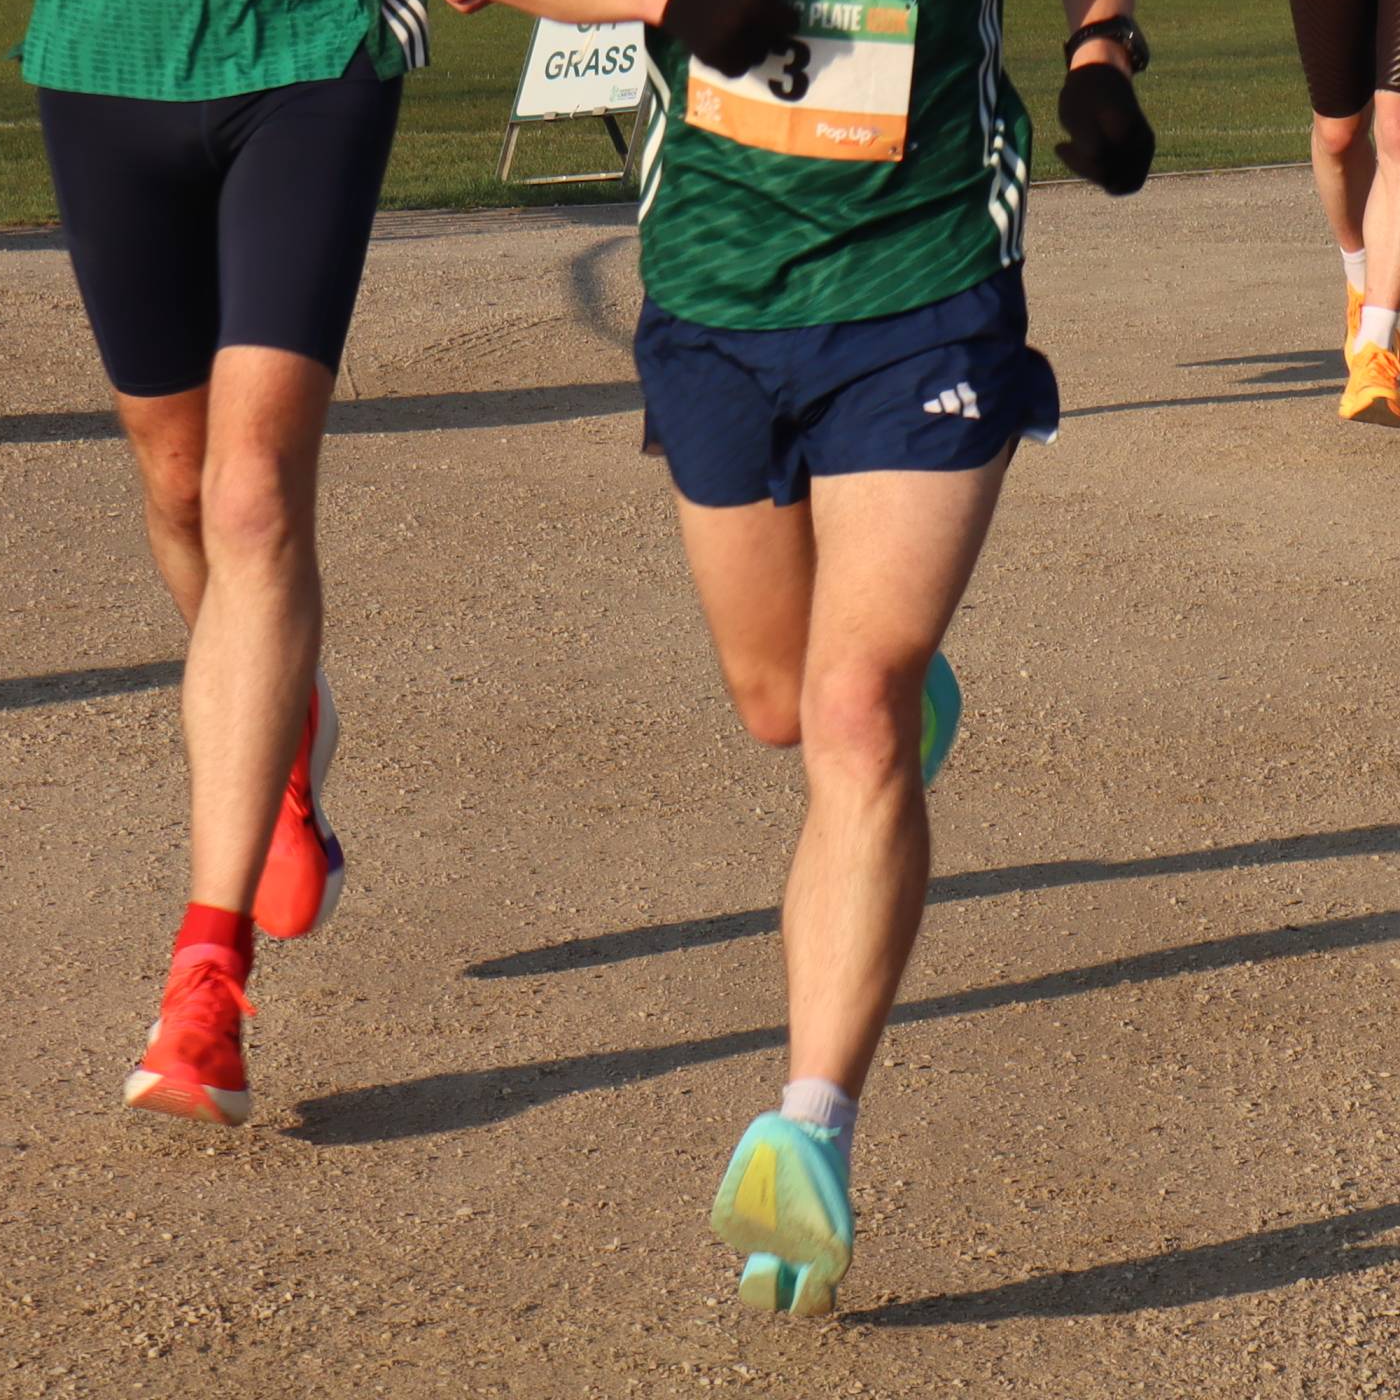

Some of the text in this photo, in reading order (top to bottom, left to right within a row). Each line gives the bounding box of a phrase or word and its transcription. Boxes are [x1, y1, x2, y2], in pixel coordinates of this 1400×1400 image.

[808, 0, 863, 31] PLATE
[545, 44, 637, 79] GRASS
[768, 40, 811, 102] 3
[816, 123, 872, 145] Pop Up
